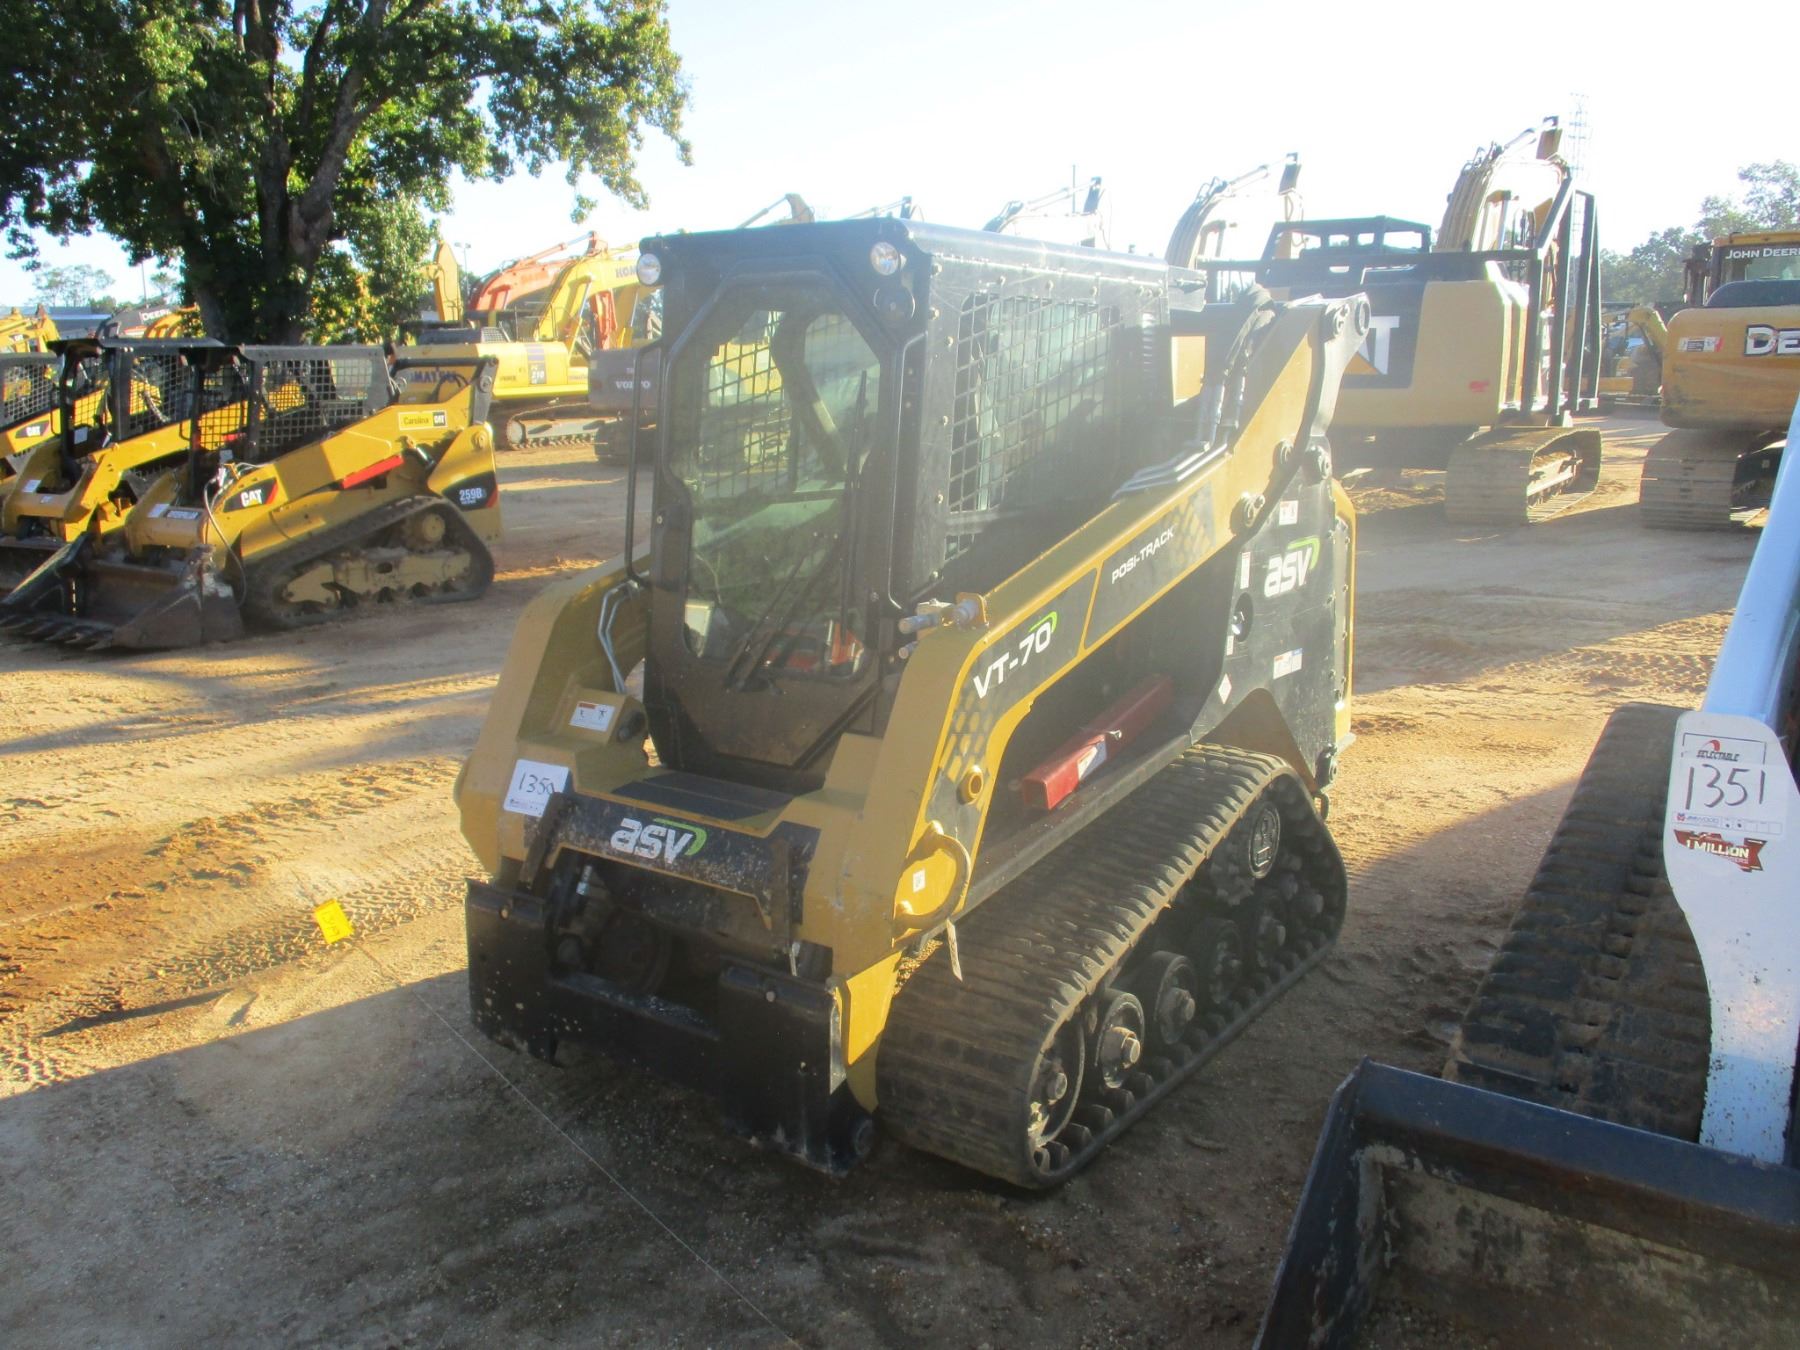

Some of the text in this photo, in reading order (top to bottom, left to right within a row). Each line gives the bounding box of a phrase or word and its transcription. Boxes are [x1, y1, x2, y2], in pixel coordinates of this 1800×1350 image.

[1726, 248, 1800, 259] JOHN DEER
[26, 426, 41, 437] CAT
[241, 489, 262, 507] CAT
[1111, 526, 1176, 585] POSI-TRACK
[973, 621, 1051, 699] VT-70
[1685, 763, 1766, 811] 1351
[1693, 841, 1750, 858] MILLION
